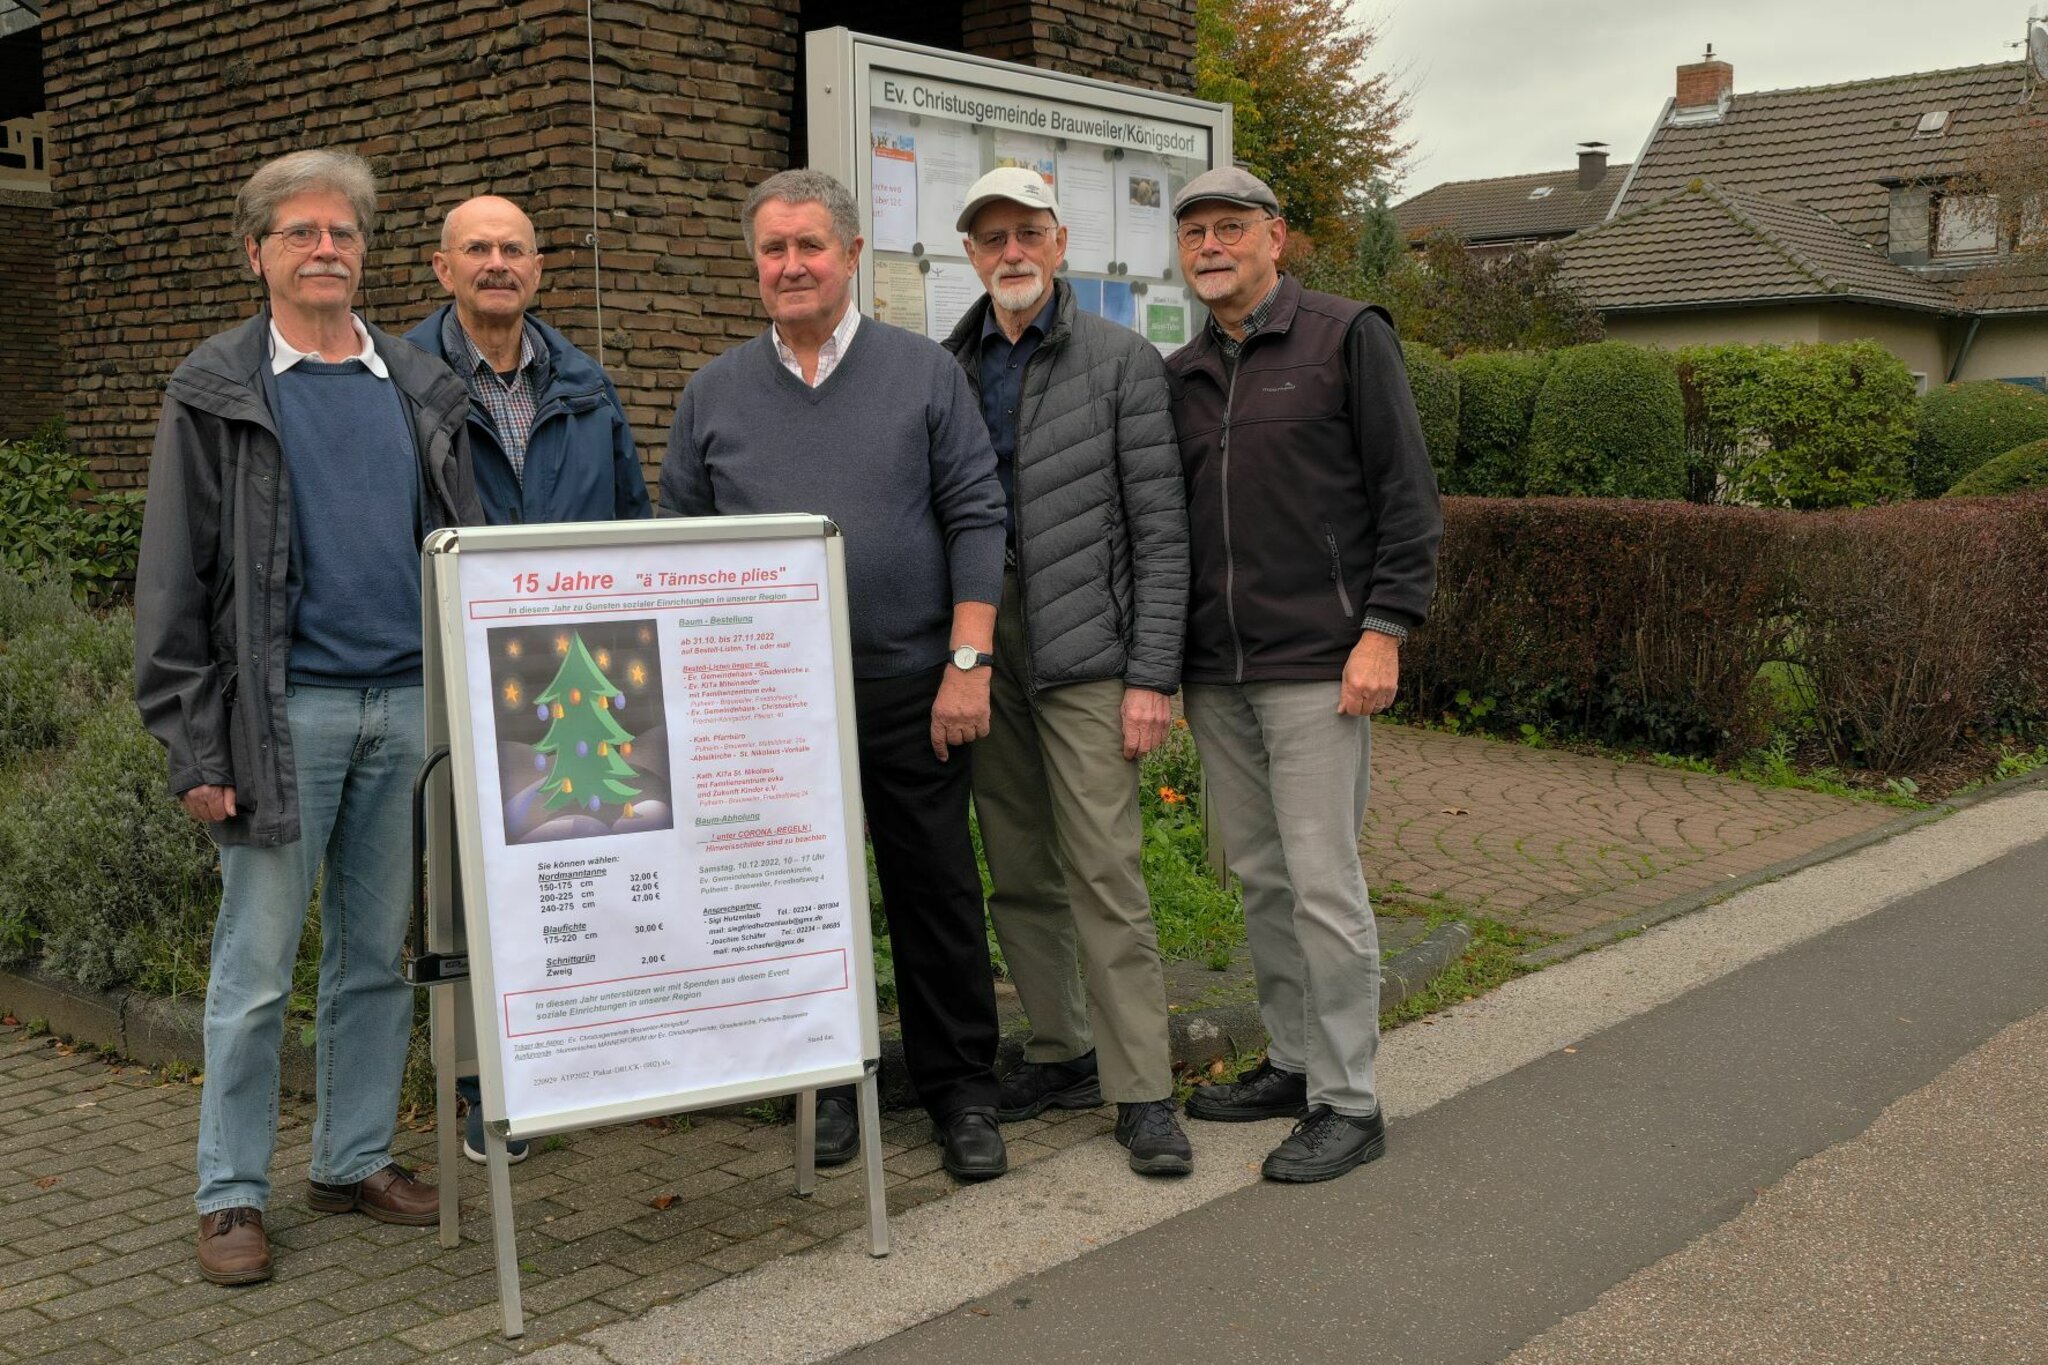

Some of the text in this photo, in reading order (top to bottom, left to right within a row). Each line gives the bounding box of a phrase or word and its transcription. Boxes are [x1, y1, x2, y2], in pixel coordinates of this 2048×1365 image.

[884, 81, 1195, 152] Ev. Christusgemeinde Brauweiler/Königsdorf
[513, 567, 786, 593] 15 Jahre "ä Tännsche plies"
[519, 604, 549, 613] diesem
[552, 602, 570, 612] Jahr
[574, 603, 583, 611] zu
[586, 602, 620, 610] Gunsten
[623, 600, 654, 609] sozialer
[657, 596, 714, 607] Einrichtungen
[717, 595, 724, 604] in
[727, 594, 756, 603] unserer
[759, 593, 787, 602] Region
[679, 616, 753, 627] Baum Bestellung
[681, 637, 691, 646] ab
[693, 636, 716, 644] 31.10.
[718, 635, 730, 643] bis
[681, 647, 693, 655] auf
[701, 670, 753, 680] Gemeindehaus
[759, 668, 803, 676] Gnadenkirche
[719, 679, 760, 688] Miteinander
[702, 689, 759, 698] Familienzentrum
[691, 702, 808, 717] Ev. Gemeindehaus Christuskirche
[694, 733, 746, 743] Kath. Pfarrbüro
[751, 749, 780, 757] Nikolaus
[745, 767, 774, 775] Nikolaus
[697, 781, 708, 789] mit
[710, 778, 766, 788] Familienzentrum
[697, 790, 710, 798] und
[712, 788, 739, 796] Zukunft
[741, 786, 764, 794] Kinder
[695, 812, 760, 827] Baum-Abholung
[716, 828, 772, 841] unter CORONA
[706, 840, 765, 852] Hinweisschilder
[795, 834, 827, 843] beachten
[538, 856, 620, 871] Sie können wählen:
[699, 853, 825, 874] Samstag, 10.12.2022, 10 17 Uhr
[538, 867, 607, 882] Nordmanntanne
[539, 882, 572, 892] 150-175
[630, 873, 651, 882] 32,00
[653, 872, 658, 880] €
[712, 872, 763, 883] Gemeindehaus
[540, 893, 573, 902] 200-225
[631, 883, 652, 892] 42,00
[654, 882, 659, 890] €
[700, 885, 728, 895] Pulheim
[774, 875, 819, 886] Friedhofsweg
[541, 903, 574, 913] 240-275
[582, 901, 595, 909] cm
[632, 894, 653, 903] 47,00
[724, 913, 760, 922] Hutzenlaub
[793, 905, 812, 914] 02234
[543, 923, 587, 935] Blaufichte
[544, 934, 577, 945] 175-220
[635, 924, 657, 933] 30,00
[658, 923, 663, 931] €
[711, 937, 739, 946] Joachim
[741, 933, 766, 941] Schäfer
[797, 925, 815, 934] 02234
[546, 954, 596, 968] Schnittgrün
[547, 968, 572, 977] Zweig
[642, 956, 659, 964] 2,00
[536, 1002, 544, 1010] In
[546, 999, 577, 1008] diesem
[580, 996, 598, 1004] Jahr
[600, 989, 651, 1001] unterstützen
[683, 978, 720, 990] Spenden
[738, 972, 766, 982] diesem
[768, 969, 790, 978] Event
[537, 992, 702, 1020] soziale Einrichtungen in unserer Region
